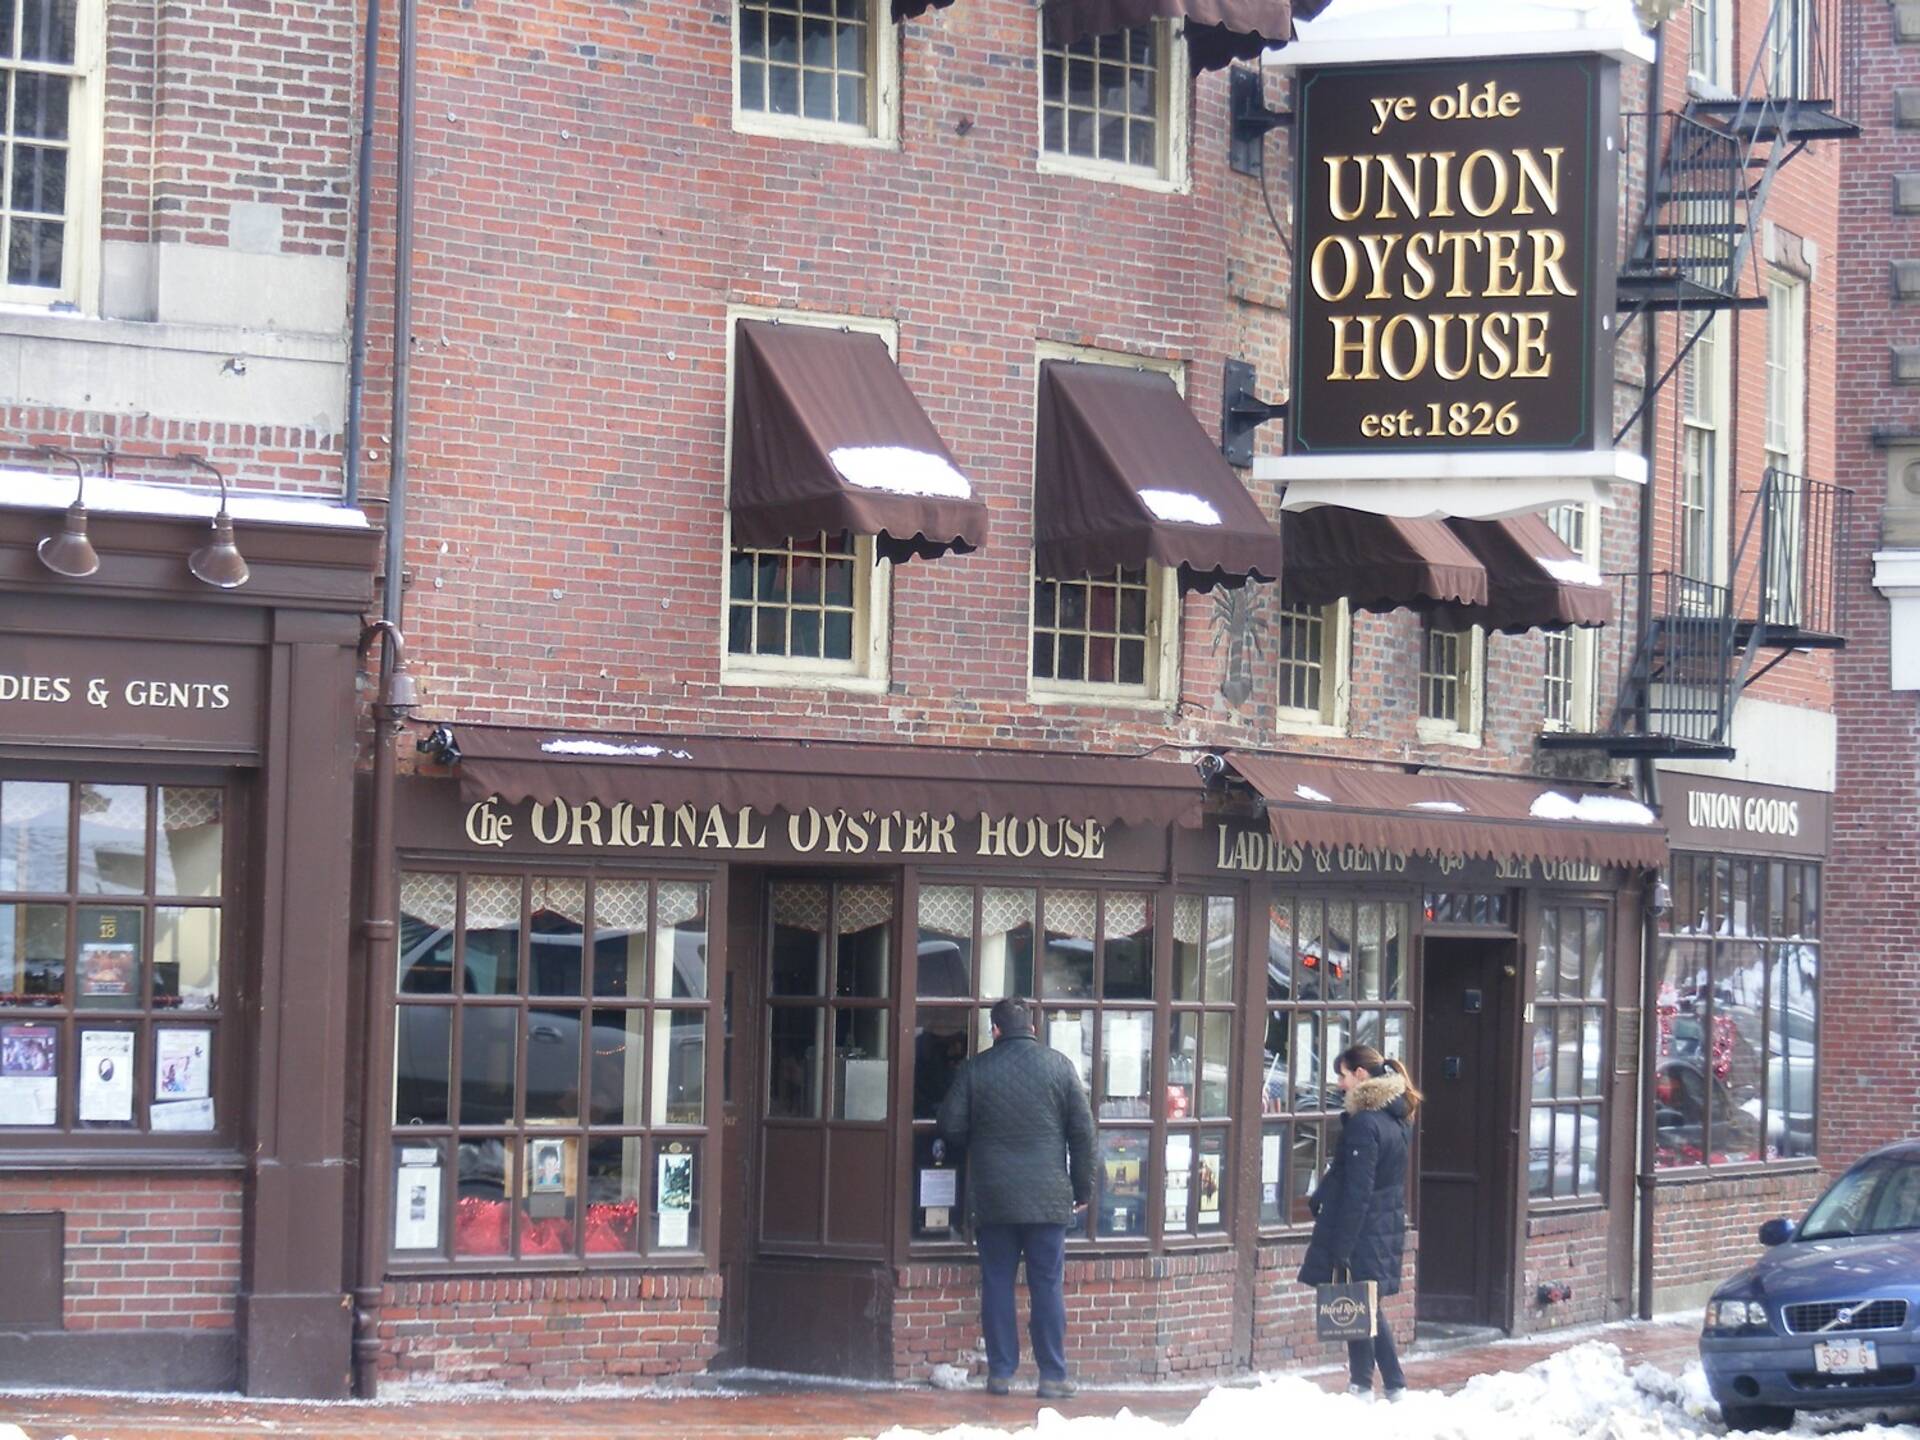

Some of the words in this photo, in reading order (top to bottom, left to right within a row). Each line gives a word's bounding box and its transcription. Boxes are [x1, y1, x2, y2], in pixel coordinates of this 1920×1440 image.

[1371, 94, 1416, 135] ye
[1429, 81, 1521, 121] olde
[1323, 147, 1565, 222] UNION
[1310, 228, 1577, 302] OYSTER
[1326, 311, 1552, 381] HOUSE
[86, 678, 110, 708] &
[124, 680, 230, 709] GENTS
[530, 796, 767, 849] ORIGINAL
[787, 806, 958, 854] OYSTER
[976, 811, 1105, 859] HOUSE
[1687, 790, 1741, 831] UNION
[1744, 797, 1800, 837] GOODS
[1216, 824, 1304, 872] LADIES
